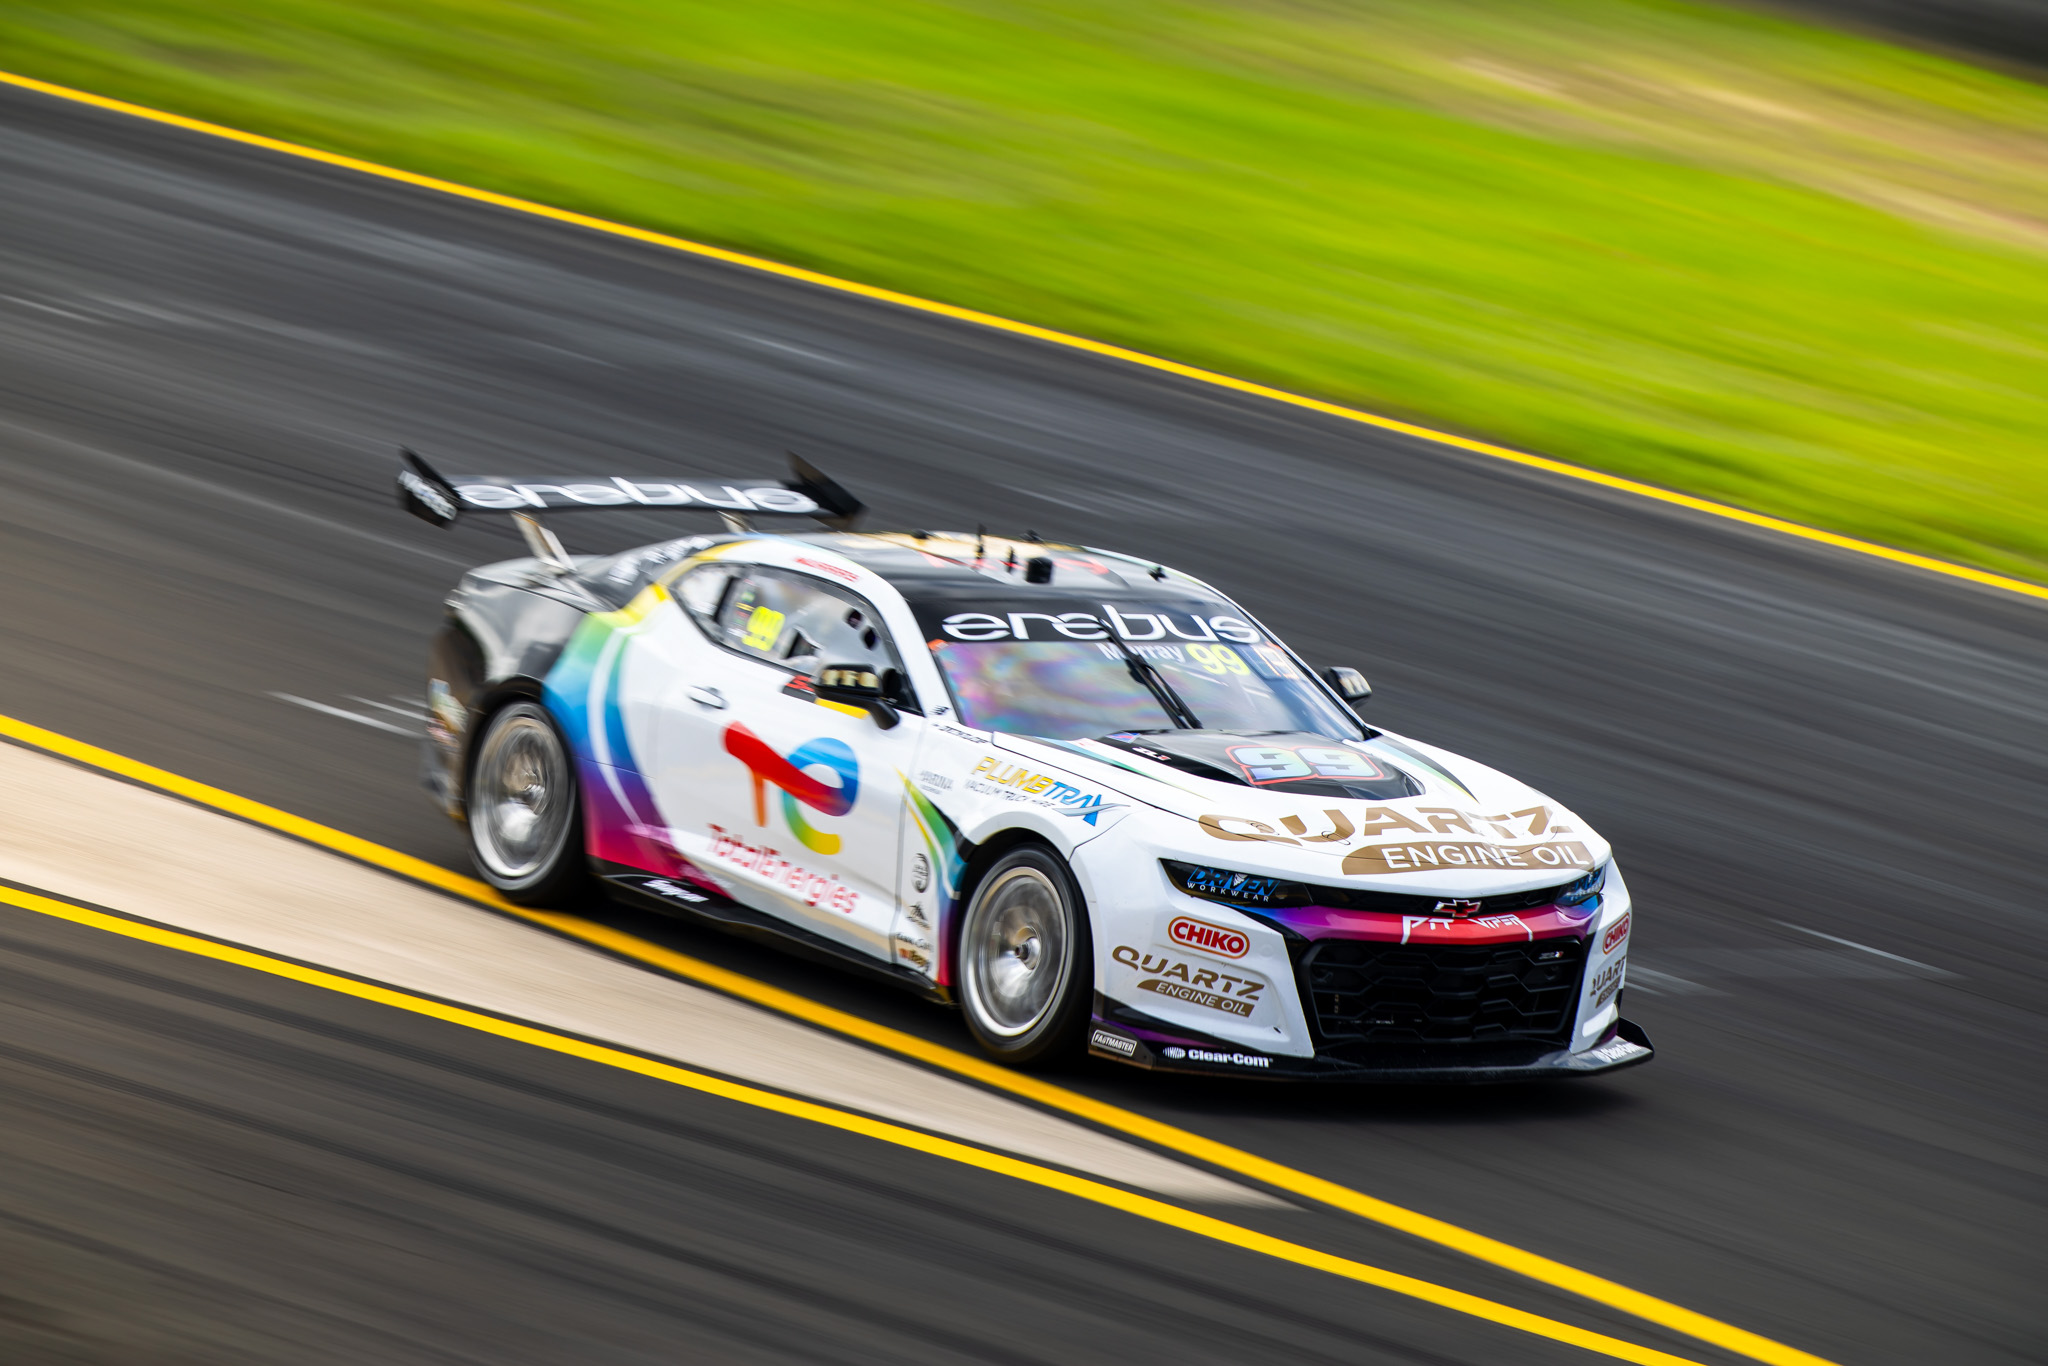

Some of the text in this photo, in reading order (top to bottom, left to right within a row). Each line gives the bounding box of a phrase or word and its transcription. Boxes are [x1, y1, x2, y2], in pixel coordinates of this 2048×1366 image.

[942, 604, 1260, 643] erebus
[1184, 642, 1251, 676] 99
[1230, 746, 1379, 783] 99
[971, 756, 1104, 827] PLUMBTRAX
[1199, 805, 1574, 847] QUARTZ
[706, 822, 860, 914] TotalEnergies
[1384, 845, 1590, 869] ENGINE OIL
[1187, 866, 1281, 897] DRIVEN
[1187, 881, 1269, 903] WORKWEAR
[1173, 921, 1245, 954] CHIKO
[1605, 918, 1630, 950] CHIKO
[1112, 945, 1265, 1001] QUARTZ
[1156, 982, 1247, 1016] ENGINE OIL
[1094, 1033, 1135, 1053] FASTMASTER
[1188, 1047, 1269, 1068] Clear-Com
